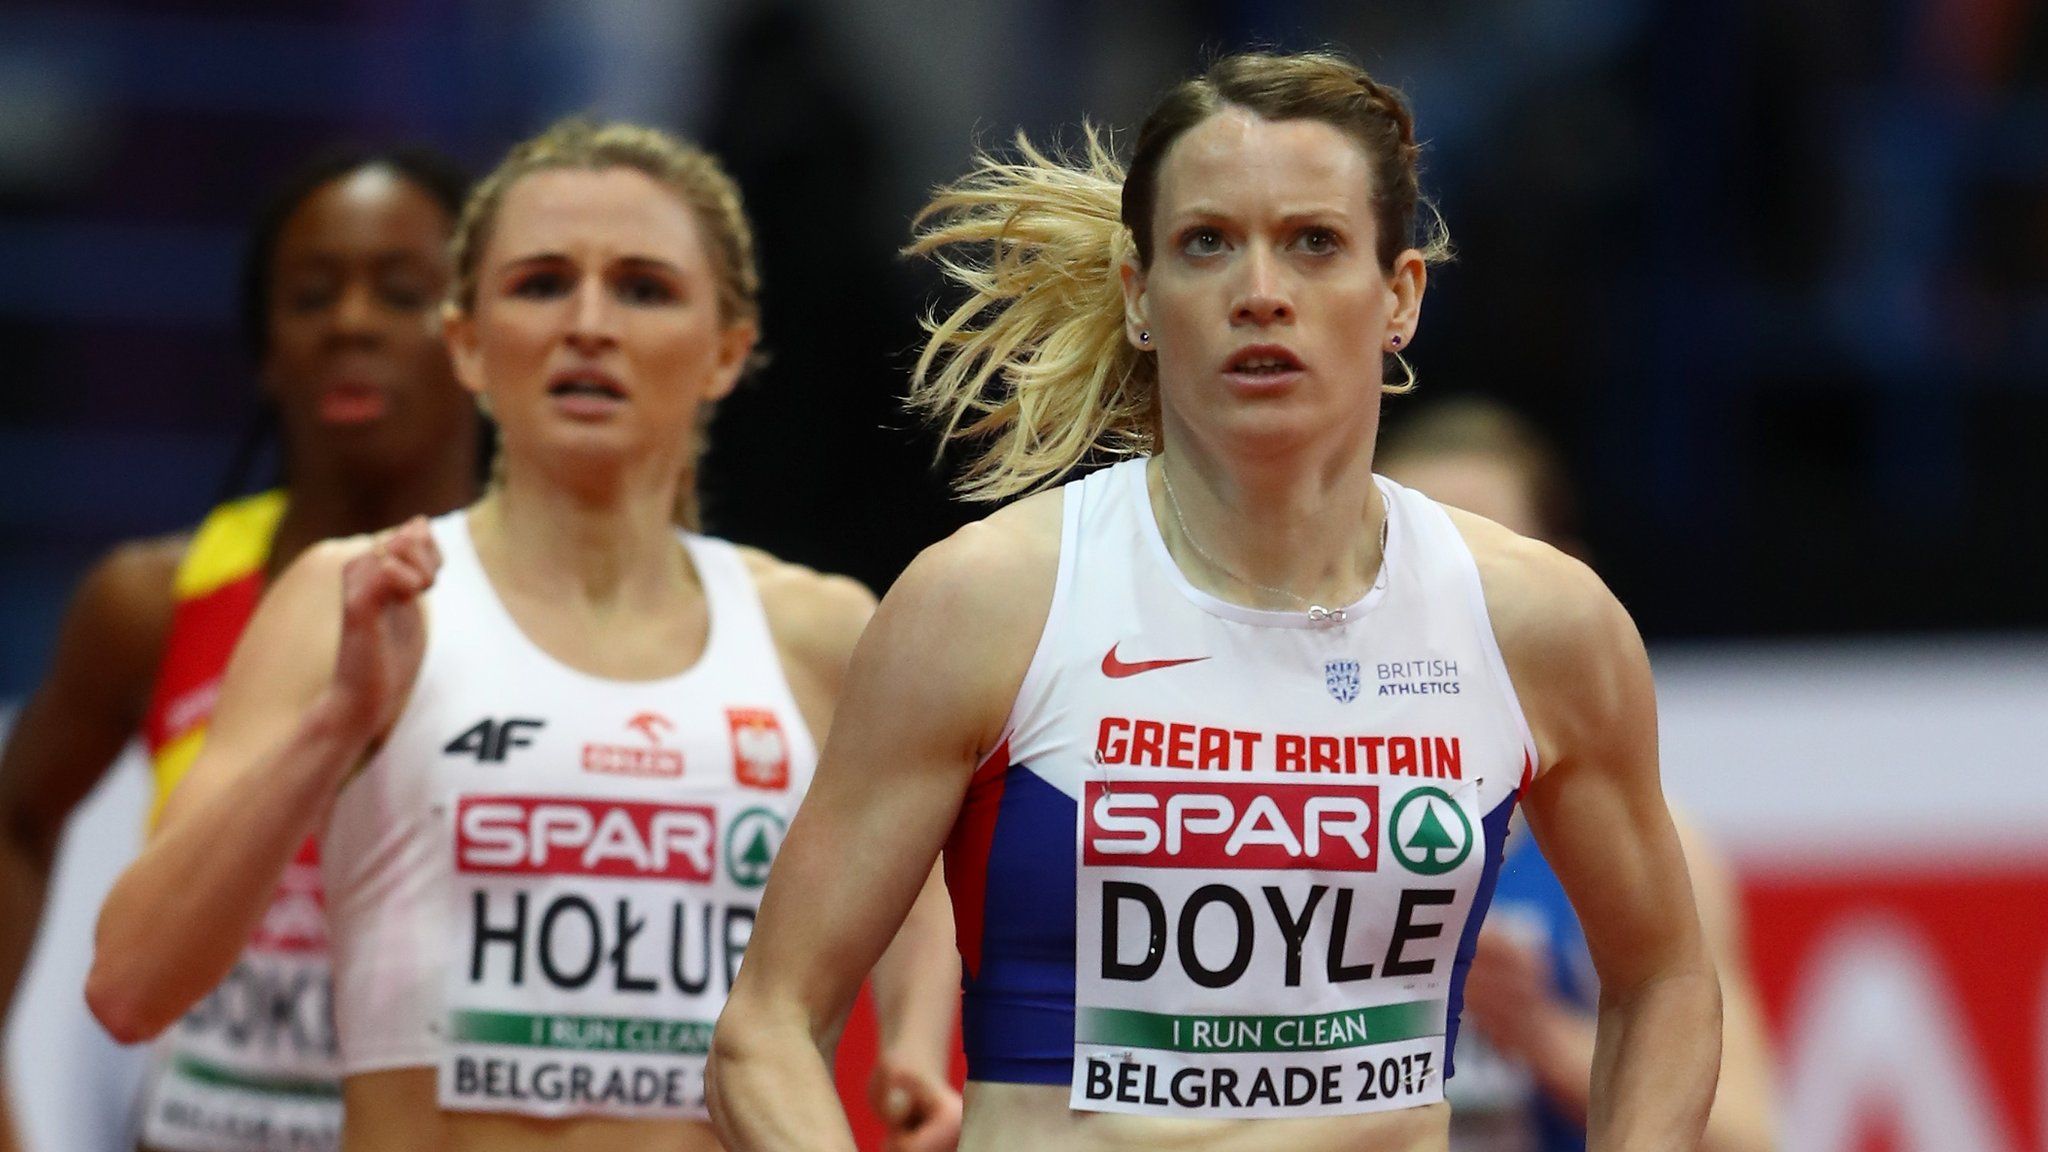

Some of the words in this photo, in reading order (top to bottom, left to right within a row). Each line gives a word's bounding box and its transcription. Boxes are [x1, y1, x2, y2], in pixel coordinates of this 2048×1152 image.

[1377, 660, 1458, 680] BRITISH
[1378, 682, 1460, 696] ATHLETICS
[443, 717, 546, 762] 4F
[1097, 717, 1262, 771] GREAT
[1275, 734, 1462, 780] BRITAIN
[461, 805, 711, 873] SPAR
[1092, 792, 1371, 859] SPAR
[1101, 881, 1456, 989] DOYLE
[1173, 1020, 1180, 1046] I
[1193, 1019, 1263, 1048] RUN
[1273, 1012, 1368, 1047] CLEAN
[454, 1055, 685, 1106] BELGRADE
[1085, 1057, 1342, 1108] BELGRADE
[1356, 1051, 1432, 1102] 2017
